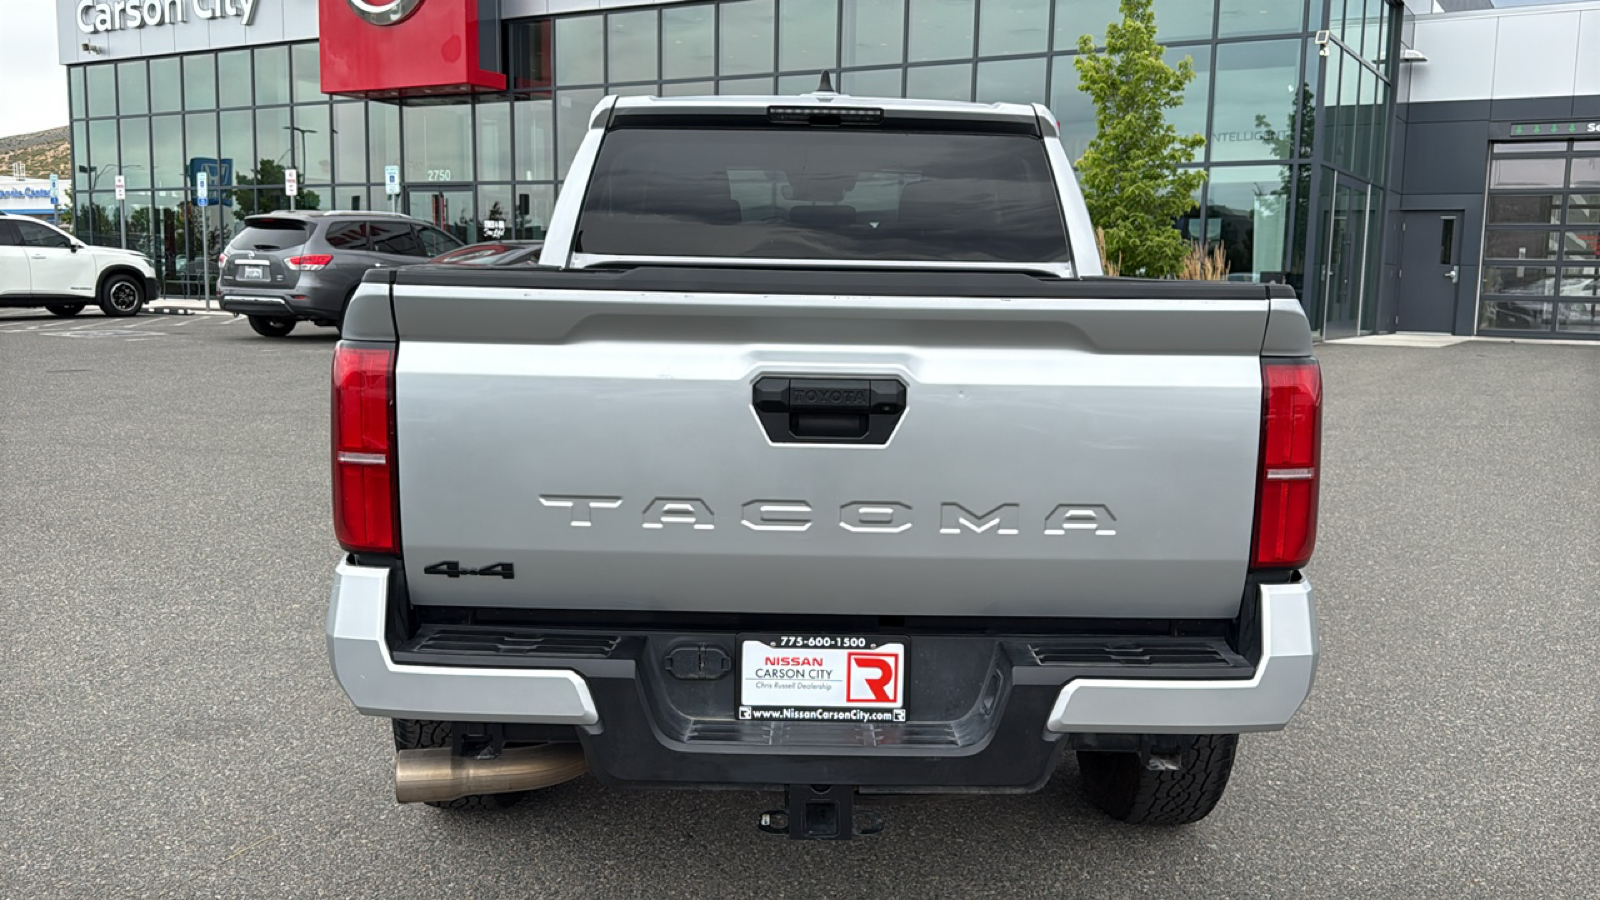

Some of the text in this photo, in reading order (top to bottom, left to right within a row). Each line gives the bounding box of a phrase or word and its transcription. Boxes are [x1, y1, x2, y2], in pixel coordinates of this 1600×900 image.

[76, 0, 258, 34] Carson City
[428, 170, 451, 181] 2750
[794, 389, 866, 404] TOYOTA
[539, 493, 1117, 536] TACOMA
[780, 636, 866, 647] 775-600-1500
[764, 656, 823, 667] NISSAN
[755, 668, 833, 680] CARSON CITY
[755, 681, 832, 691] Chris Russell Dealership
[753, 708, 892, 723] www.NissanCarsonCity.com
